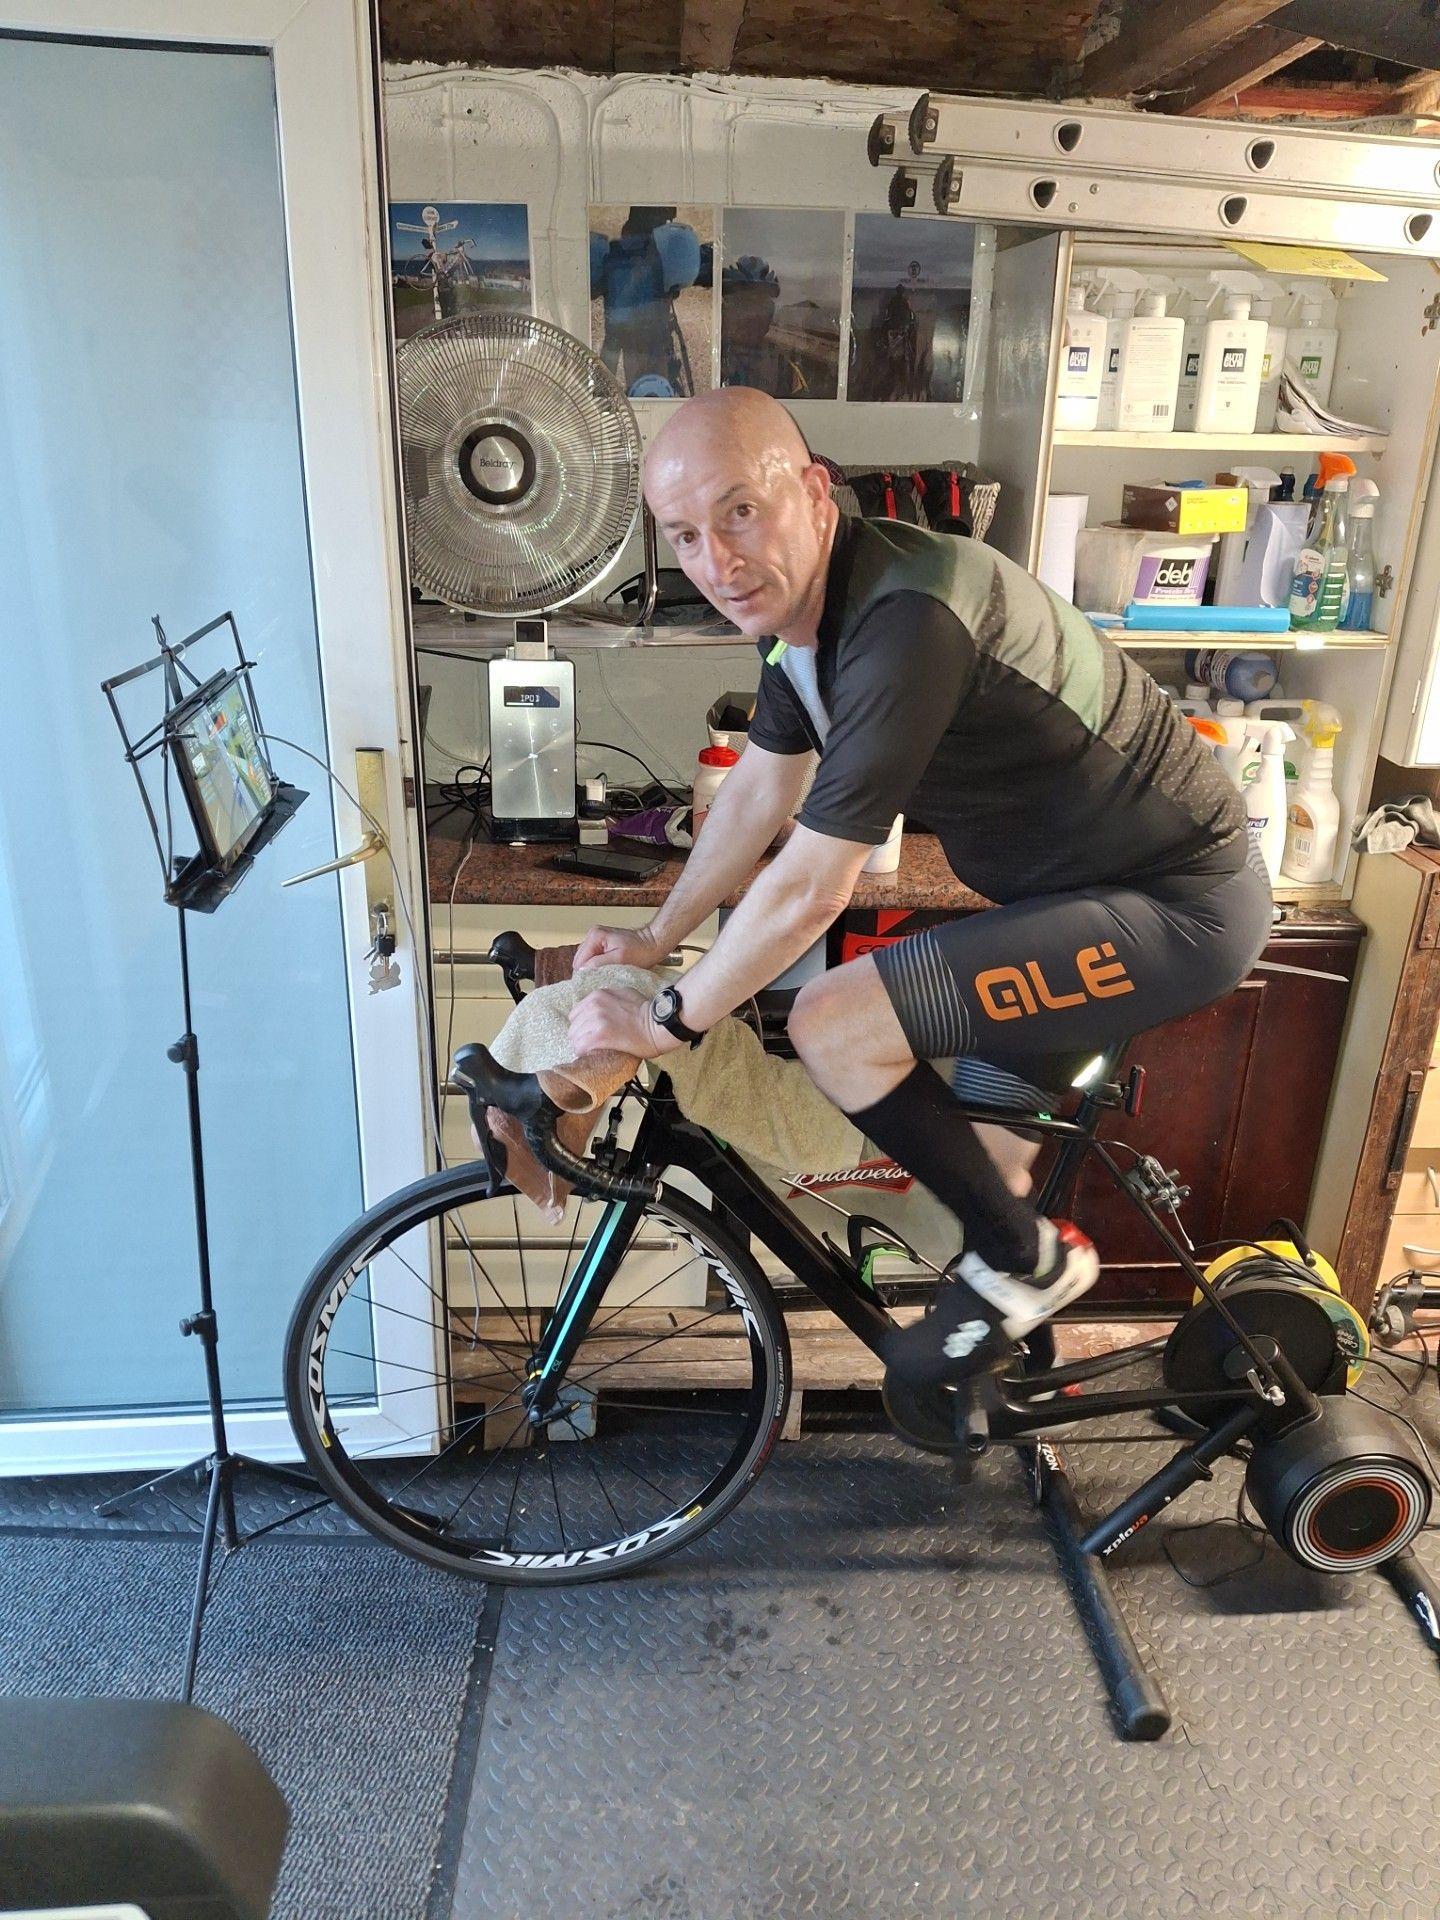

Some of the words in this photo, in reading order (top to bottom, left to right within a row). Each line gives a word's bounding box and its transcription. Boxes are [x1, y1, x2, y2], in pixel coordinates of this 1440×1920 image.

[479, 459, 514, 469] Beldray
[1156, 562, 1193, 585] deb
[789, 1162, 912, 1186] Budweis
[646, 1214, 764, 1347] OSMIC
